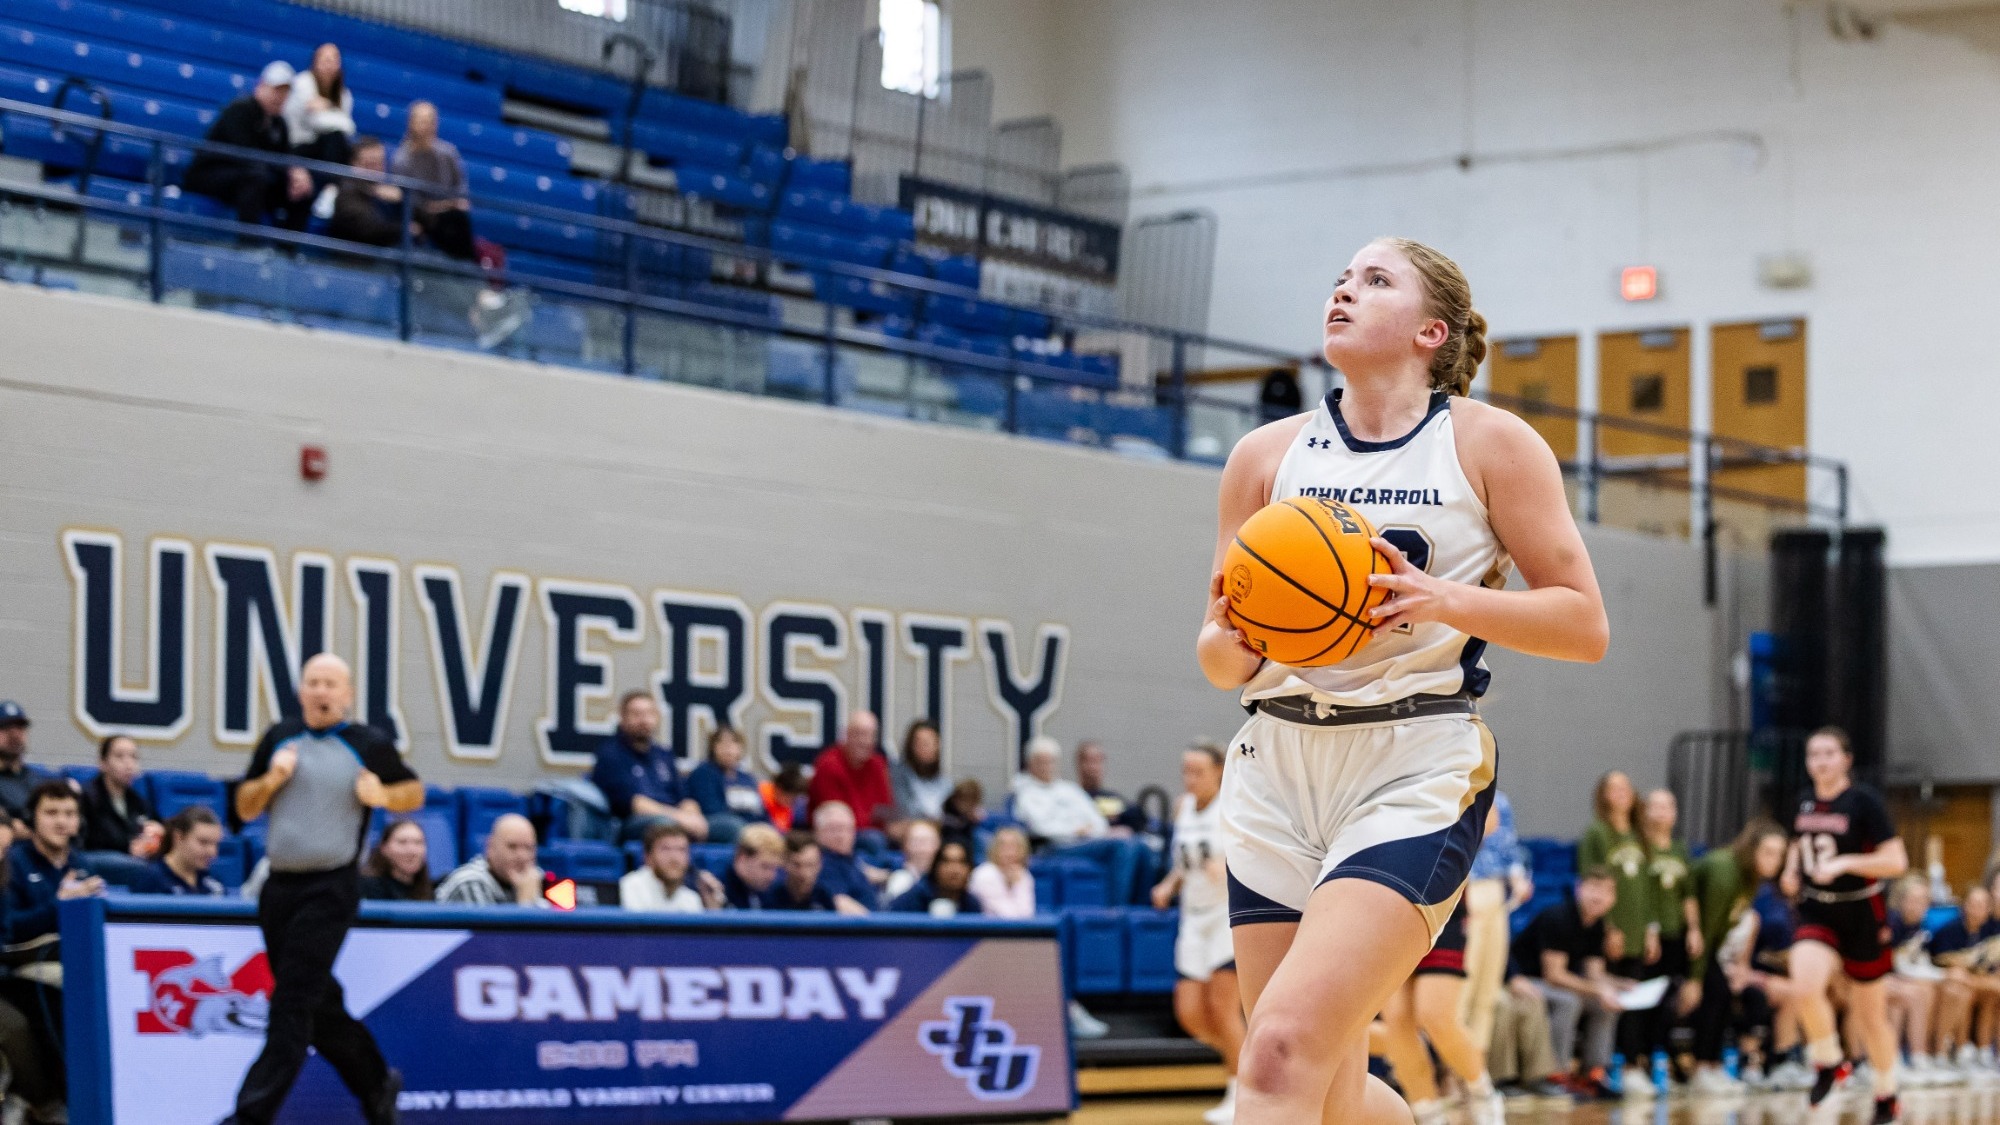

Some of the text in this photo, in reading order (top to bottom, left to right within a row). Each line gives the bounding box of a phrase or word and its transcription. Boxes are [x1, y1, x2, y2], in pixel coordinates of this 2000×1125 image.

[1317, 496, 1362, 534] CAA
[1349, 487, 1443, 506] CARROLL
[62, 527, 1070, 780] UNIVERSITY
[454, 964, 902, 1022] GAMEDAY
[396, 1089, 451, 1110] ONY
